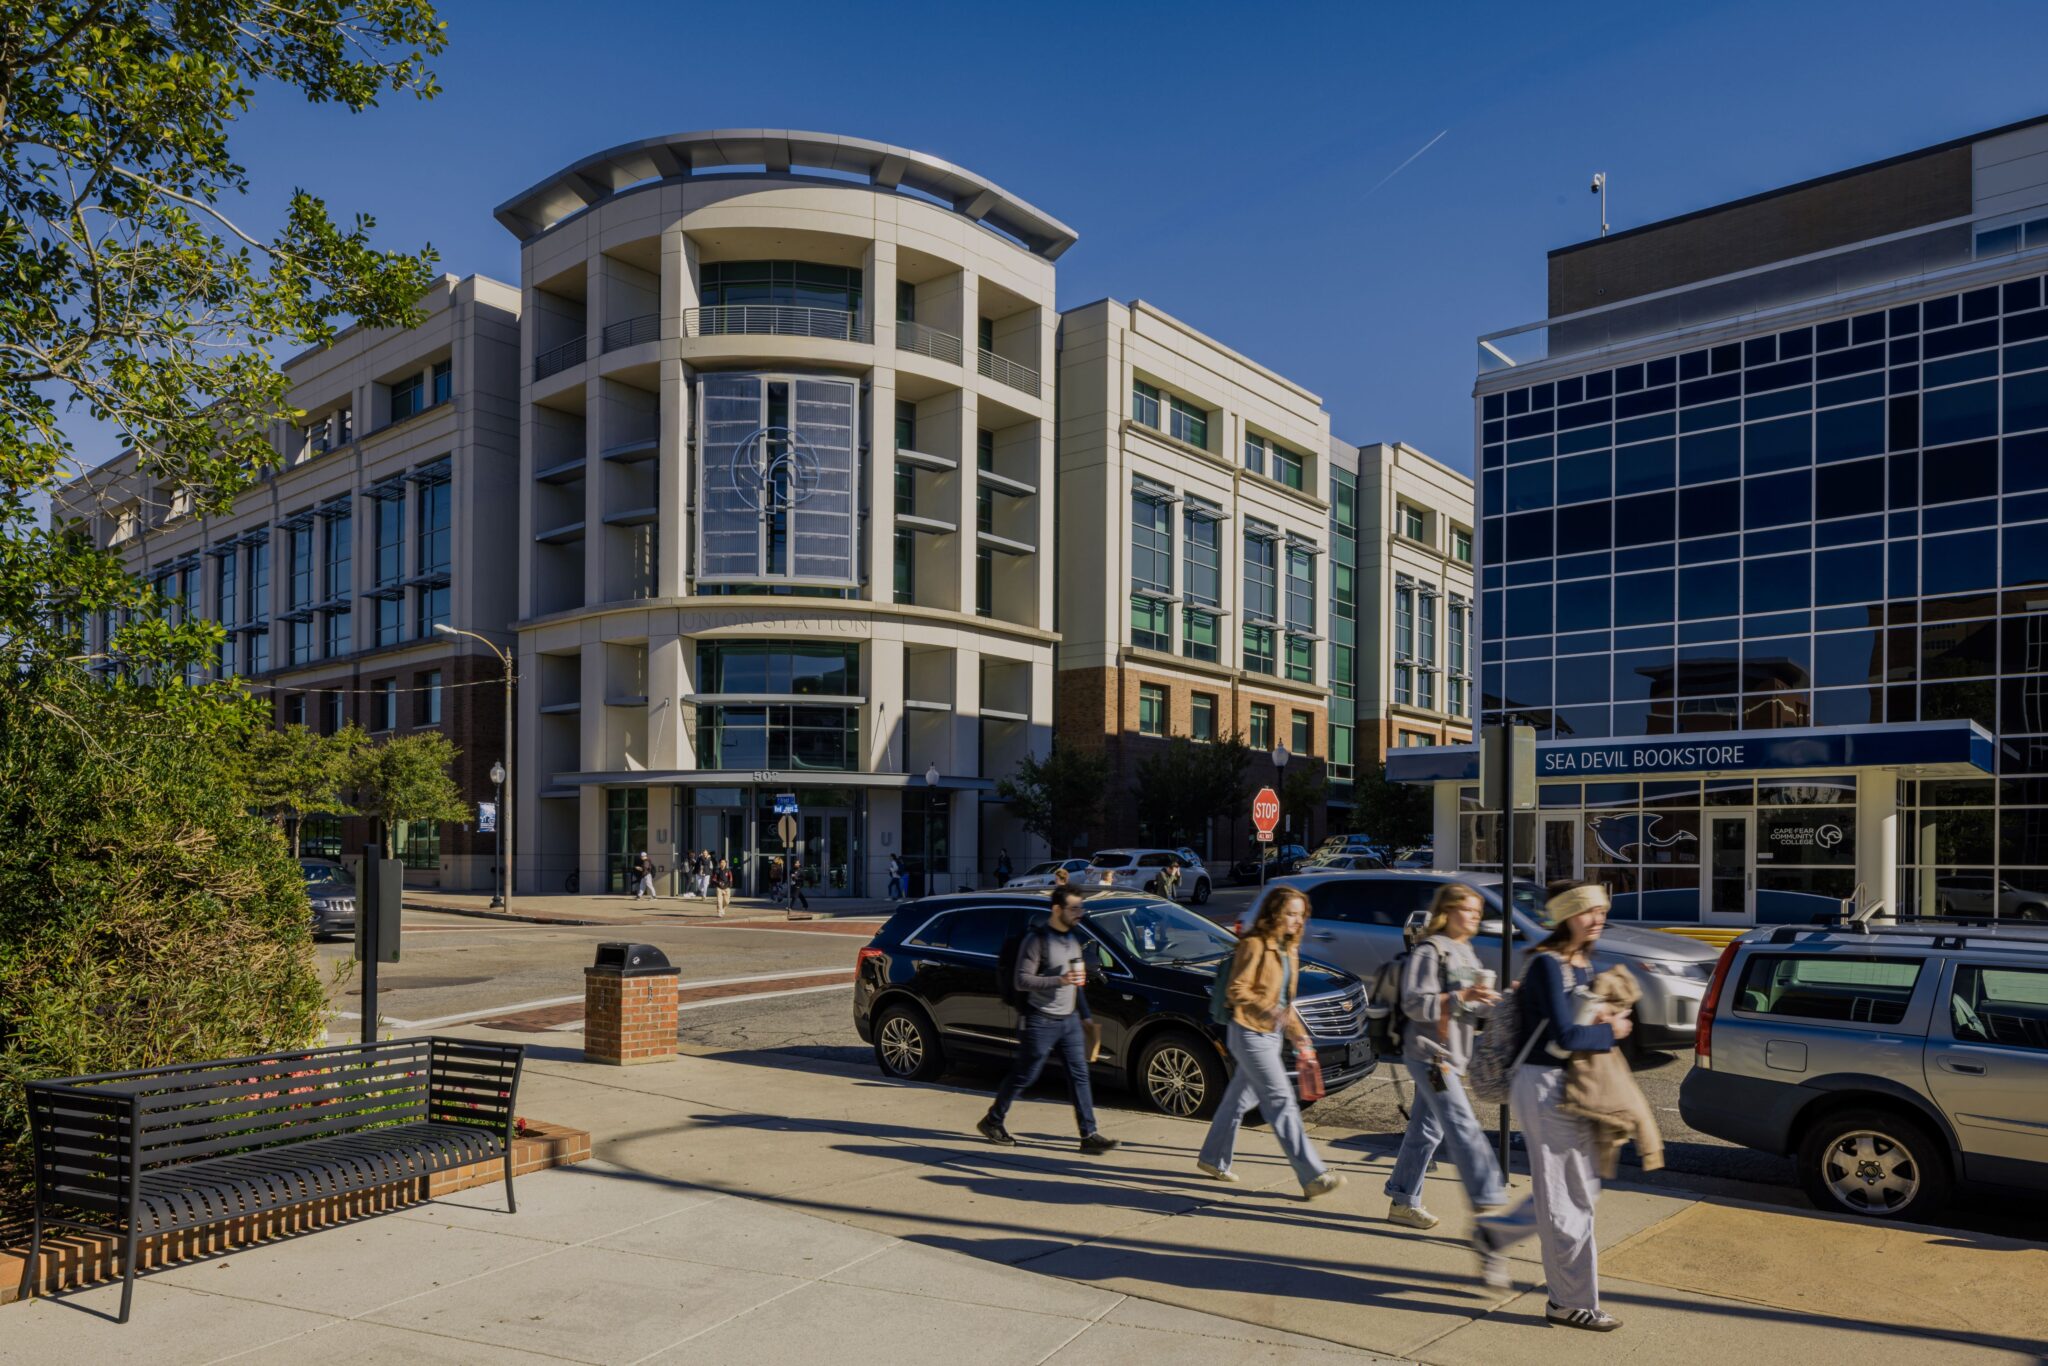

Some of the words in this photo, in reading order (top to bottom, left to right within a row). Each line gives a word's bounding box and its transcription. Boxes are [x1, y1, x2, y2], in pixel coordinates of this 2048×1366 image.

[682, 612, 755, 629] UNION
[763, 613, 868, 633] STATION
[1545, 753, 1576, 769] SEA
[1581, 751, 1628, 768] DEVIL
[1634, 745, 1744, 766] BOOKSTORE
[1256, 802, 1277, 818] STOP
